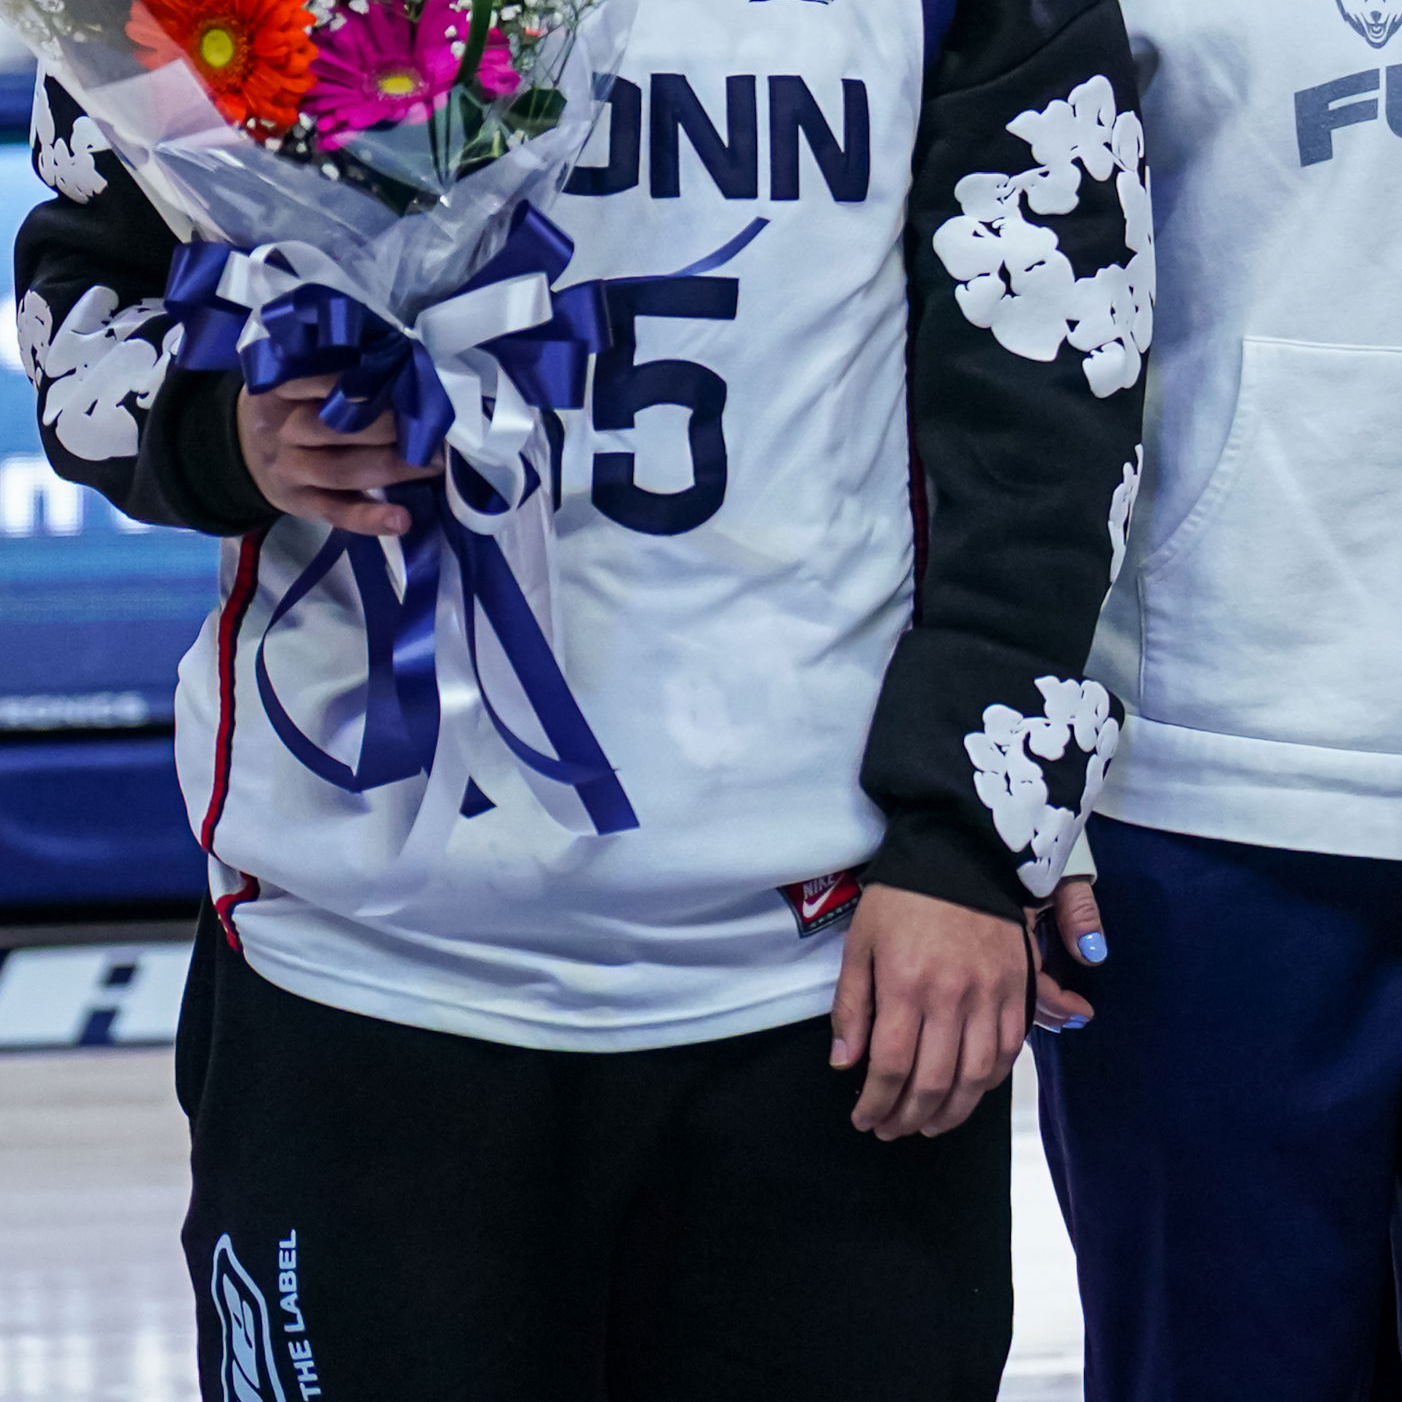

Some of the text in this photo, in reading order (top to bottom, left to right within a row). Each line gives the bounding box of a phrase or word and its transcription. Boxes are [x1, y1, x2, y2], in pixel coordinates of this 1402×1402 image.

[555, 71, 870, 202] ONN
[548, 275, 739, 537] 5
[803, 874, 837, 900] NIKE
[278, 1228, 322, 1401] THE LABEL
